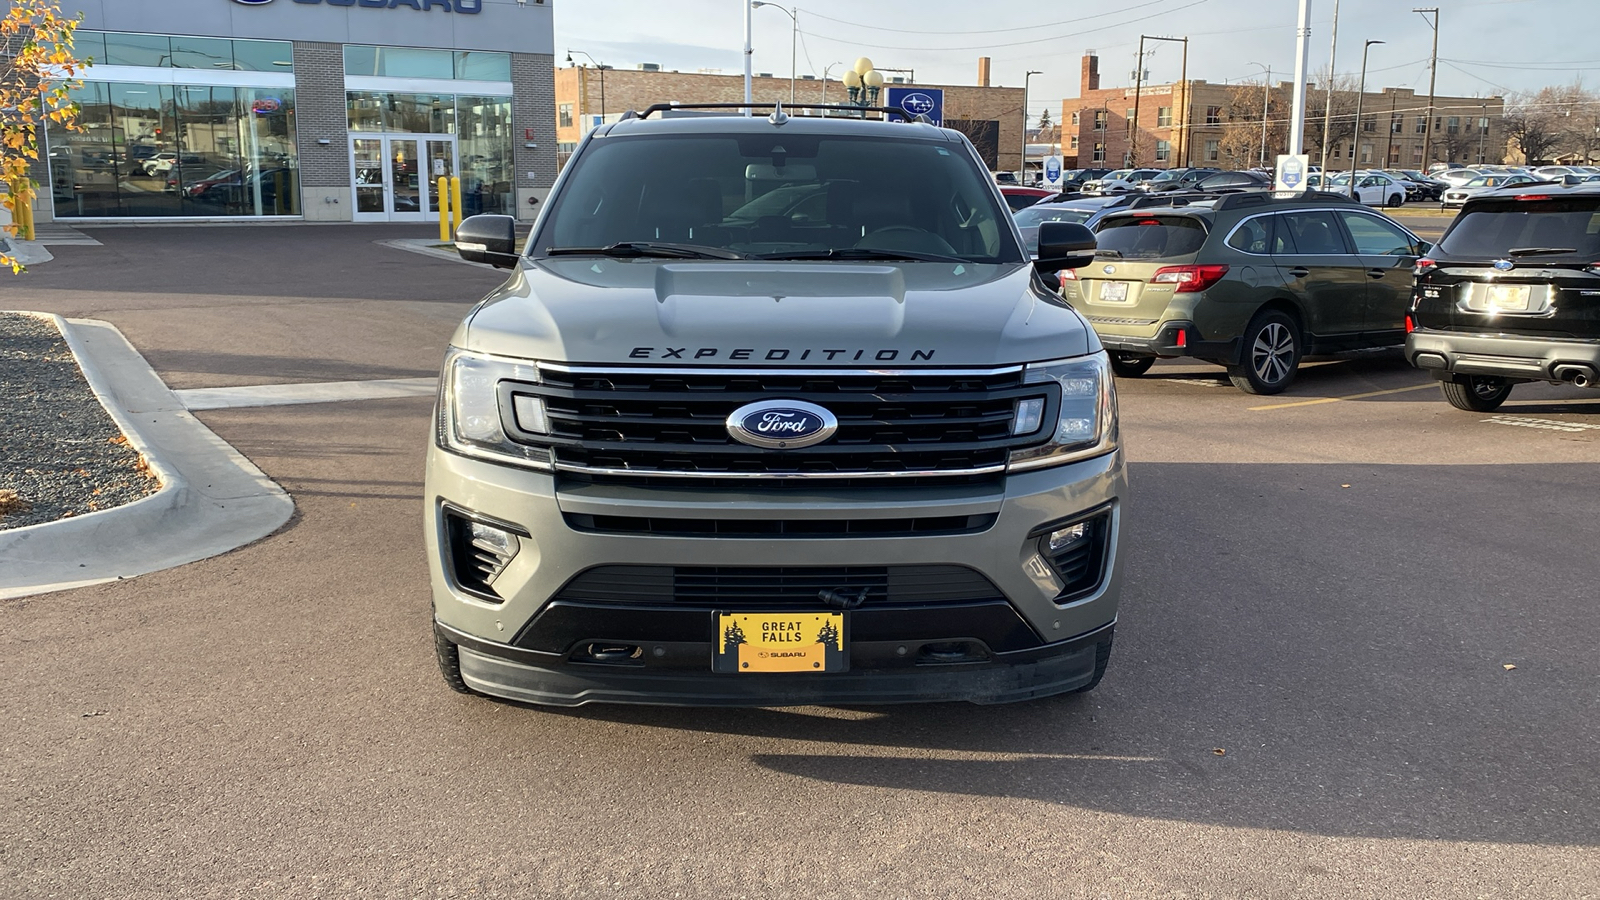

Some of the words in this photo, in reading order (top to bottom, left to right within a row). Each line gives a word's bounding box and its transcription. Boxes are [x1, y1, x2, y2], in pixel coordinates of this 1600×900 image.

[629, 347, 936, 361] EXPEDITION
[757, 412, 807, 432] Ford
[762, 622, 802, 631] GREAT
[762, 632, 802, 642] FALLS
